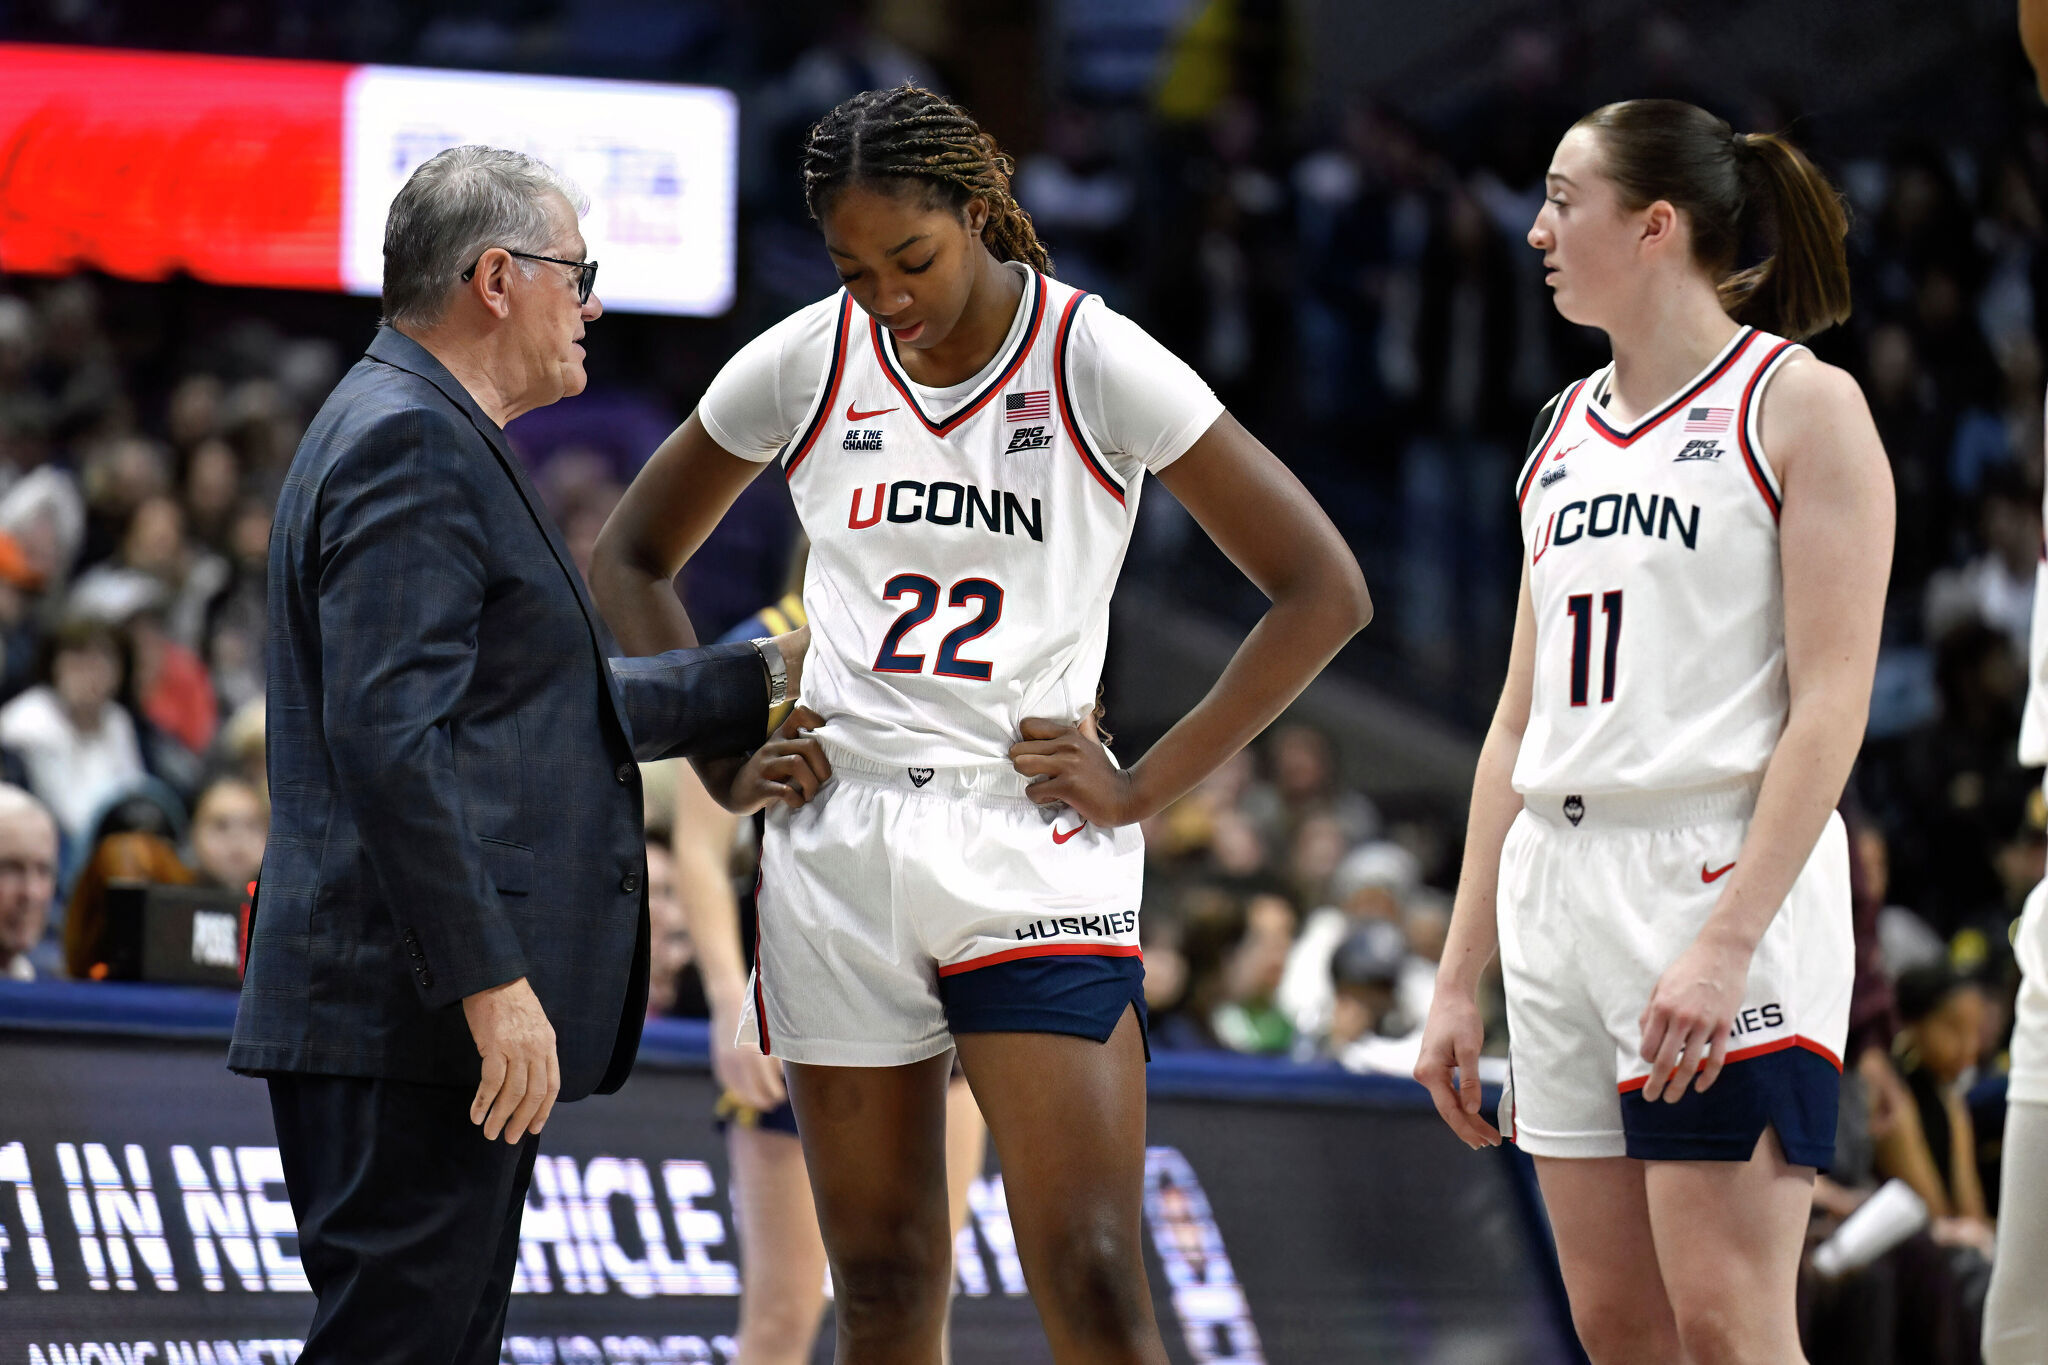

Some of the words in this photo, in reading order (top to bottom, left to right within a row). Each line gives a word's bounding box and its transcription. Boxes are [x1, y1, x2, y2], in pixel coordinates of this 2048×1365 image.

[842, 440, 883, 451] CHANGE
[846, 430, 860, 440] BE
[863, 430, 883, 440] THE
[1008, 436, 1053, 449] EAST
[1013, 426, 1045, 439] BIG
[1686, 440, 1719, 449] BIG
[848, 481, 1043, 542] UCONN
[1533, 493, 1700, 566] UCONN
[872, 573, 1004, 681] 22
[1567, 590, 1623, 707] 11
[1015, 910, 1136, 941] HUSKIES
[0, 1141, 59, 1291] 1
[56, 1143, 179, 1291] IN
[171, 1145, 312, 1291] NE
[511, 1154, 742, 1299] HICLE
